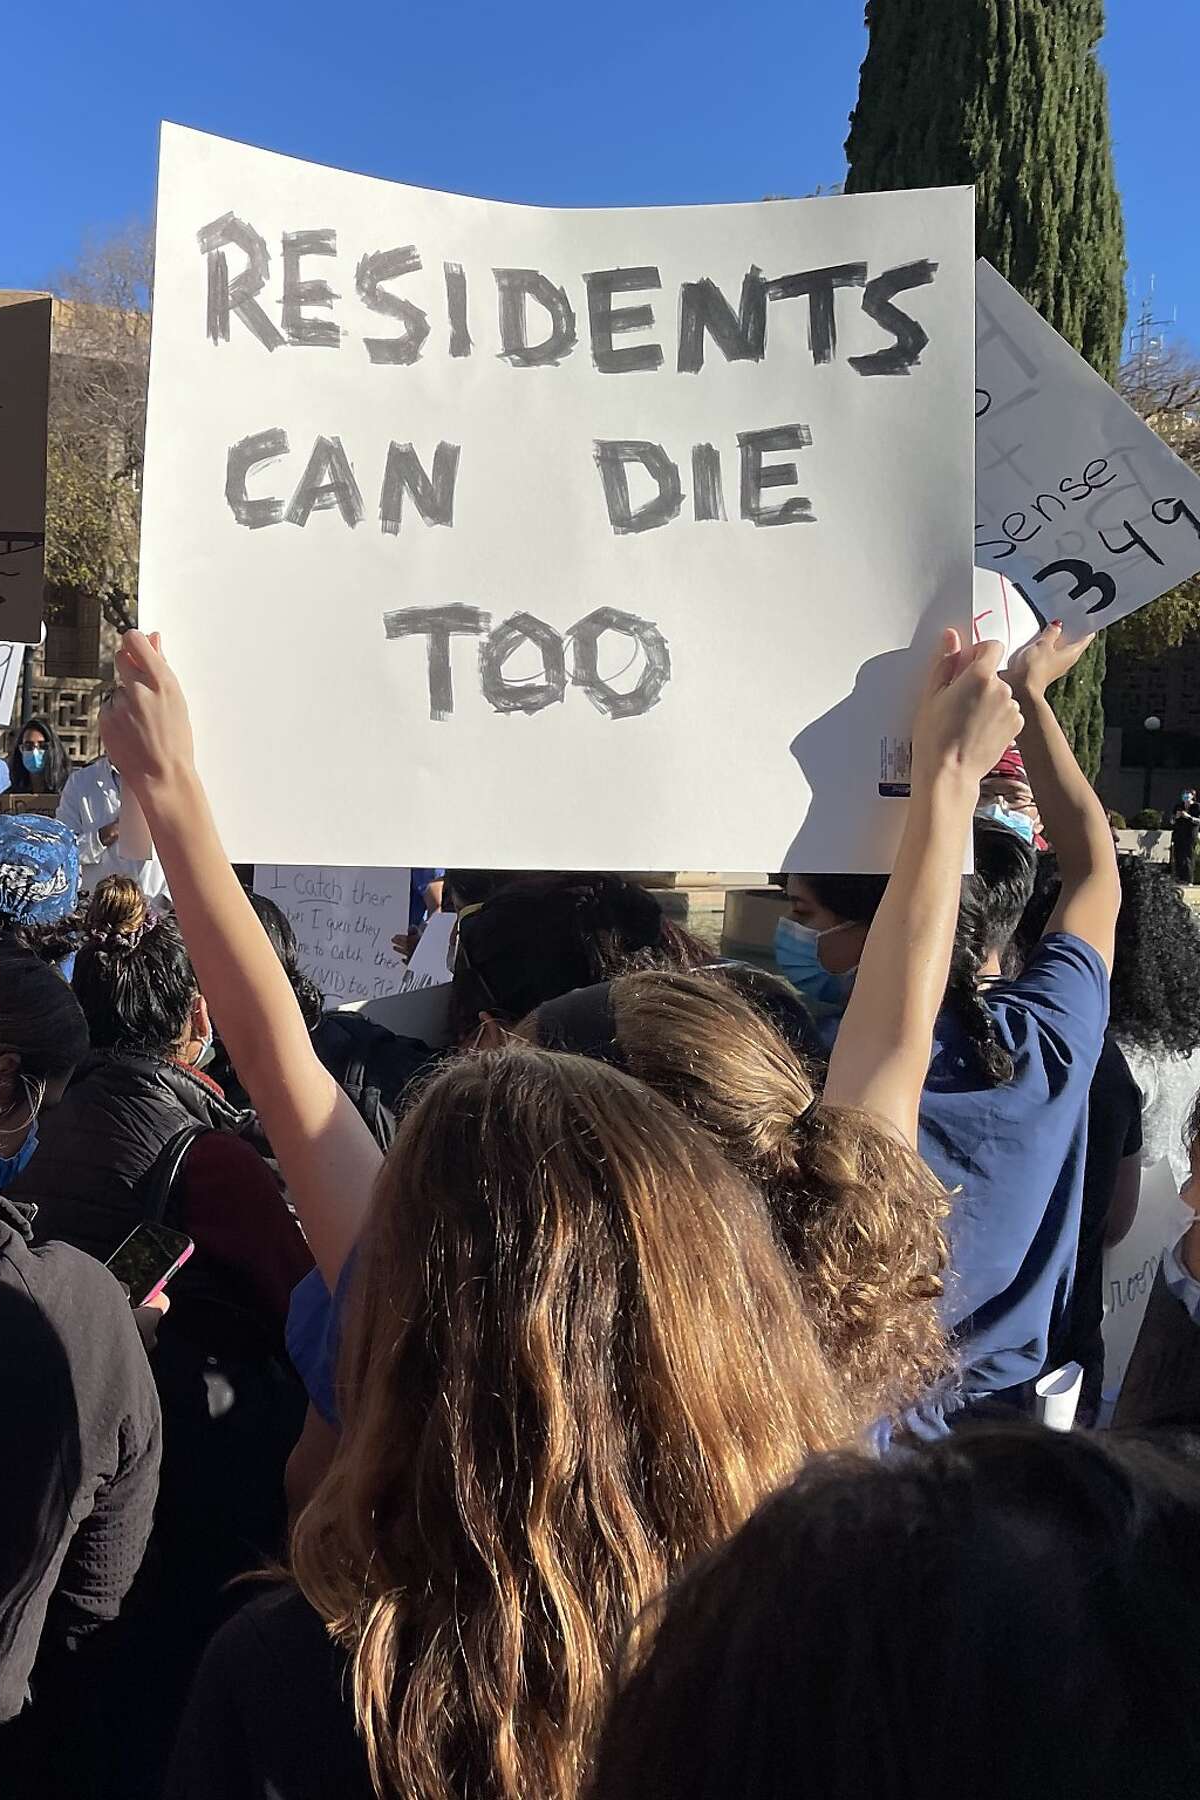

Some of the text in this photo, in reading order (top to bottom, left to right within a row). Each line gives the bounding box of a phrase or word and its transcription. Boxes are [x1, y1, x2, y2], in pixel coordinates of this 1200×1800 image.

[196, 210, 940, 377] RESIDENTS
[224, 423, 817, 536] CAN DIE
[383, 601, 672, 721] TOO
